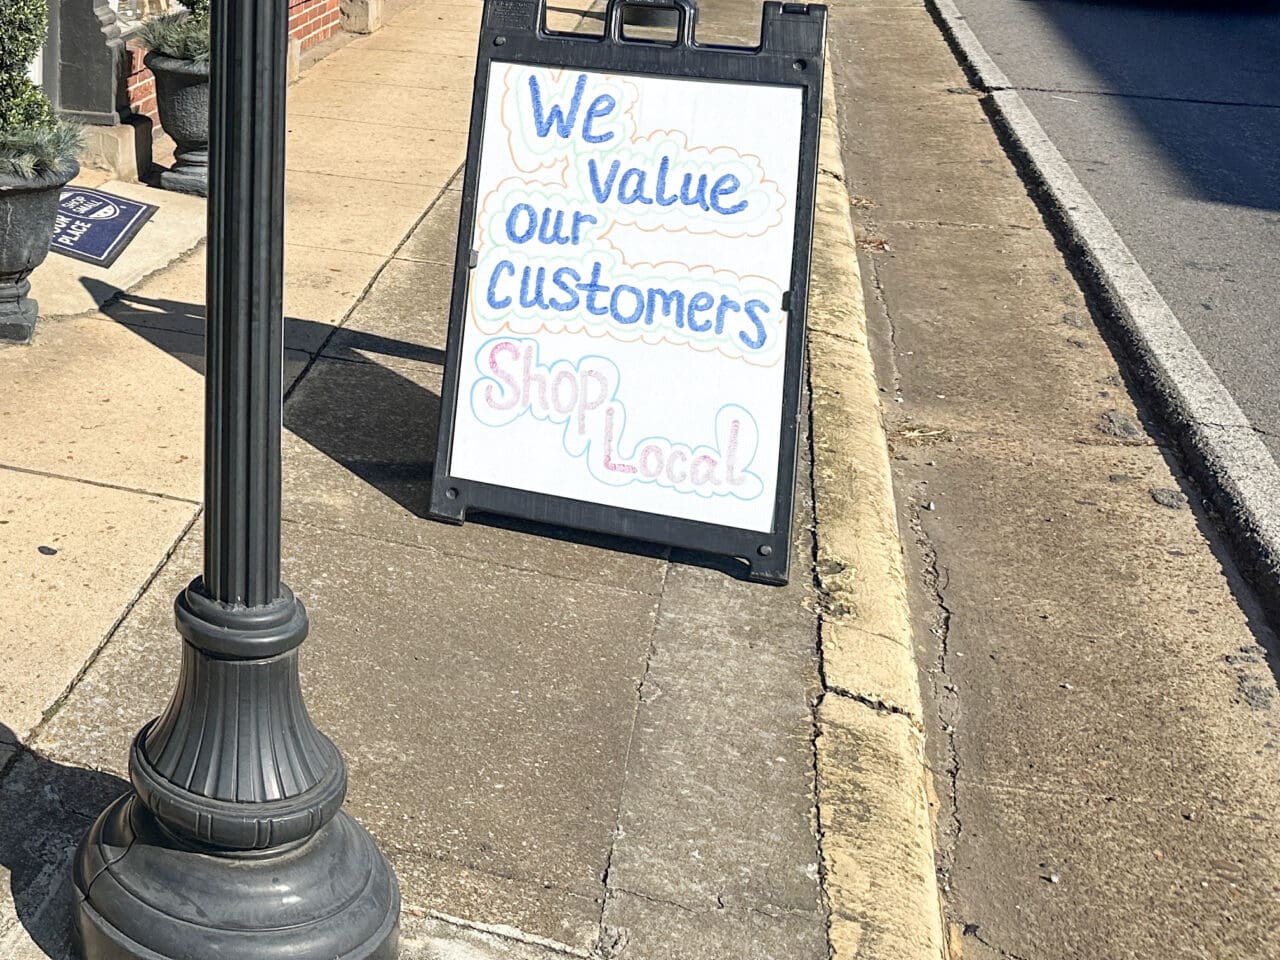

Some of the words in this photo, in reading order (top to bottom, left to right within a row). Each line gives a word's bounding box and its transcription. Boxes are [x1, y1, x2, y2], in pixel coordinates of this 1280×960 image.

[528, 74, 616, 143] We
[57, 220, 92, 246] PLACE
[505, 203, 598, 245] our
[485, 341, 608, 435] Shop
[603, 407, 746, 486] Local
